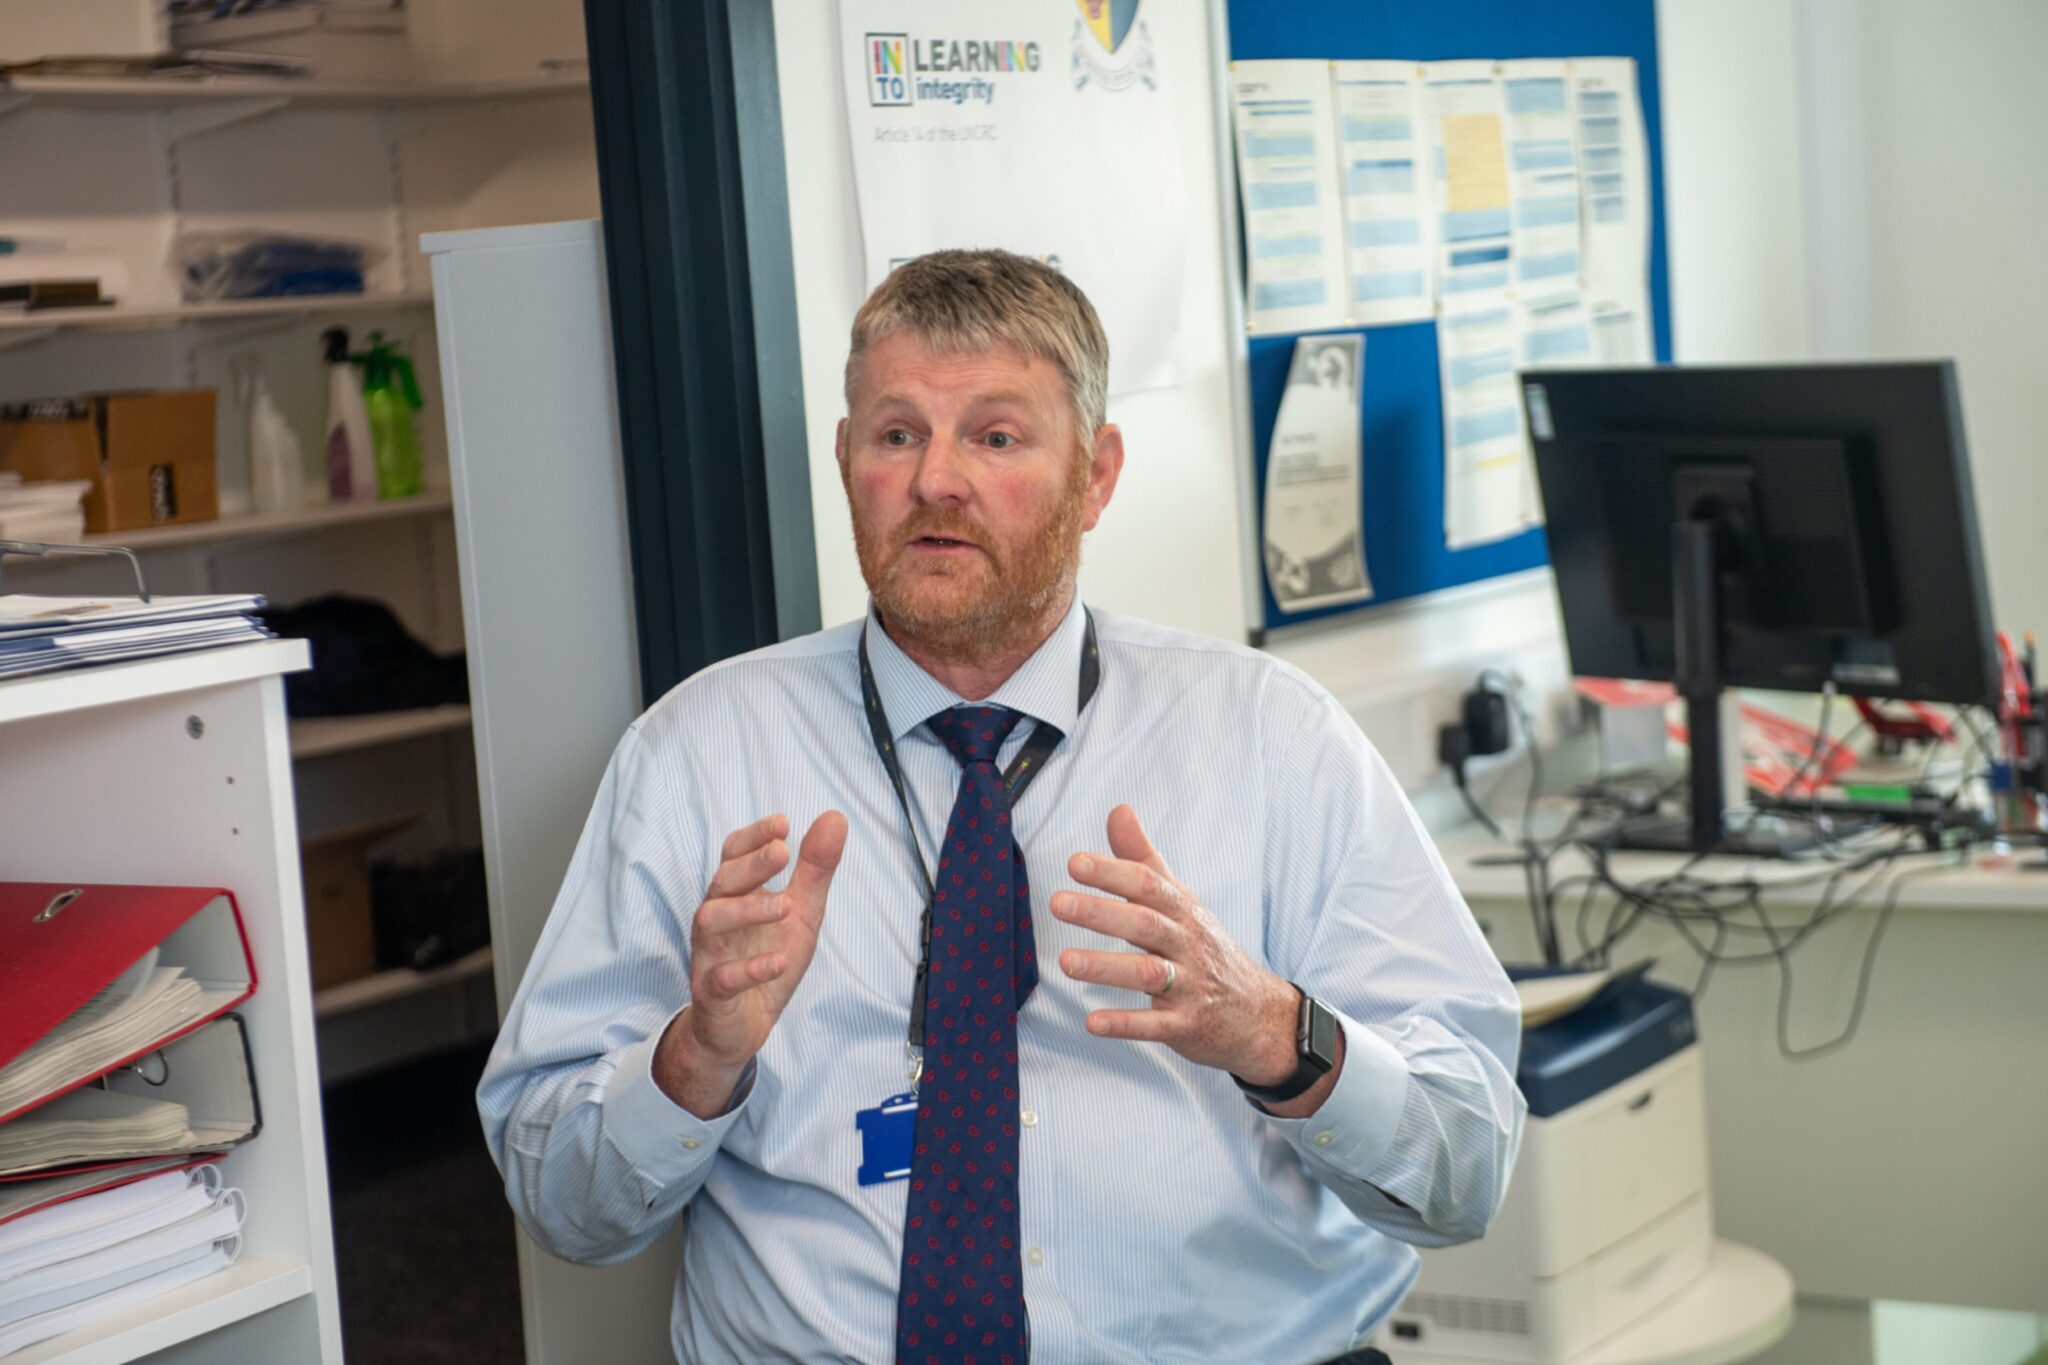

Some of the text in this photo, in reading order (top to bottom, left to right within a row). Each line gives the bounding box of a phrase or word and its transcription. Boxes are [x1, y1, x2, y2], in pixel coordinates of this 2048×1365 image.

[873, 40, 903, 74] IN
[914, 39, 1040, 72] LEARNING
[876, 77, 905, 100] TO
[916, 77, 995, 105] integrity
[873, 126, 910, 143] Article
[939, 126, 957, 141] the
